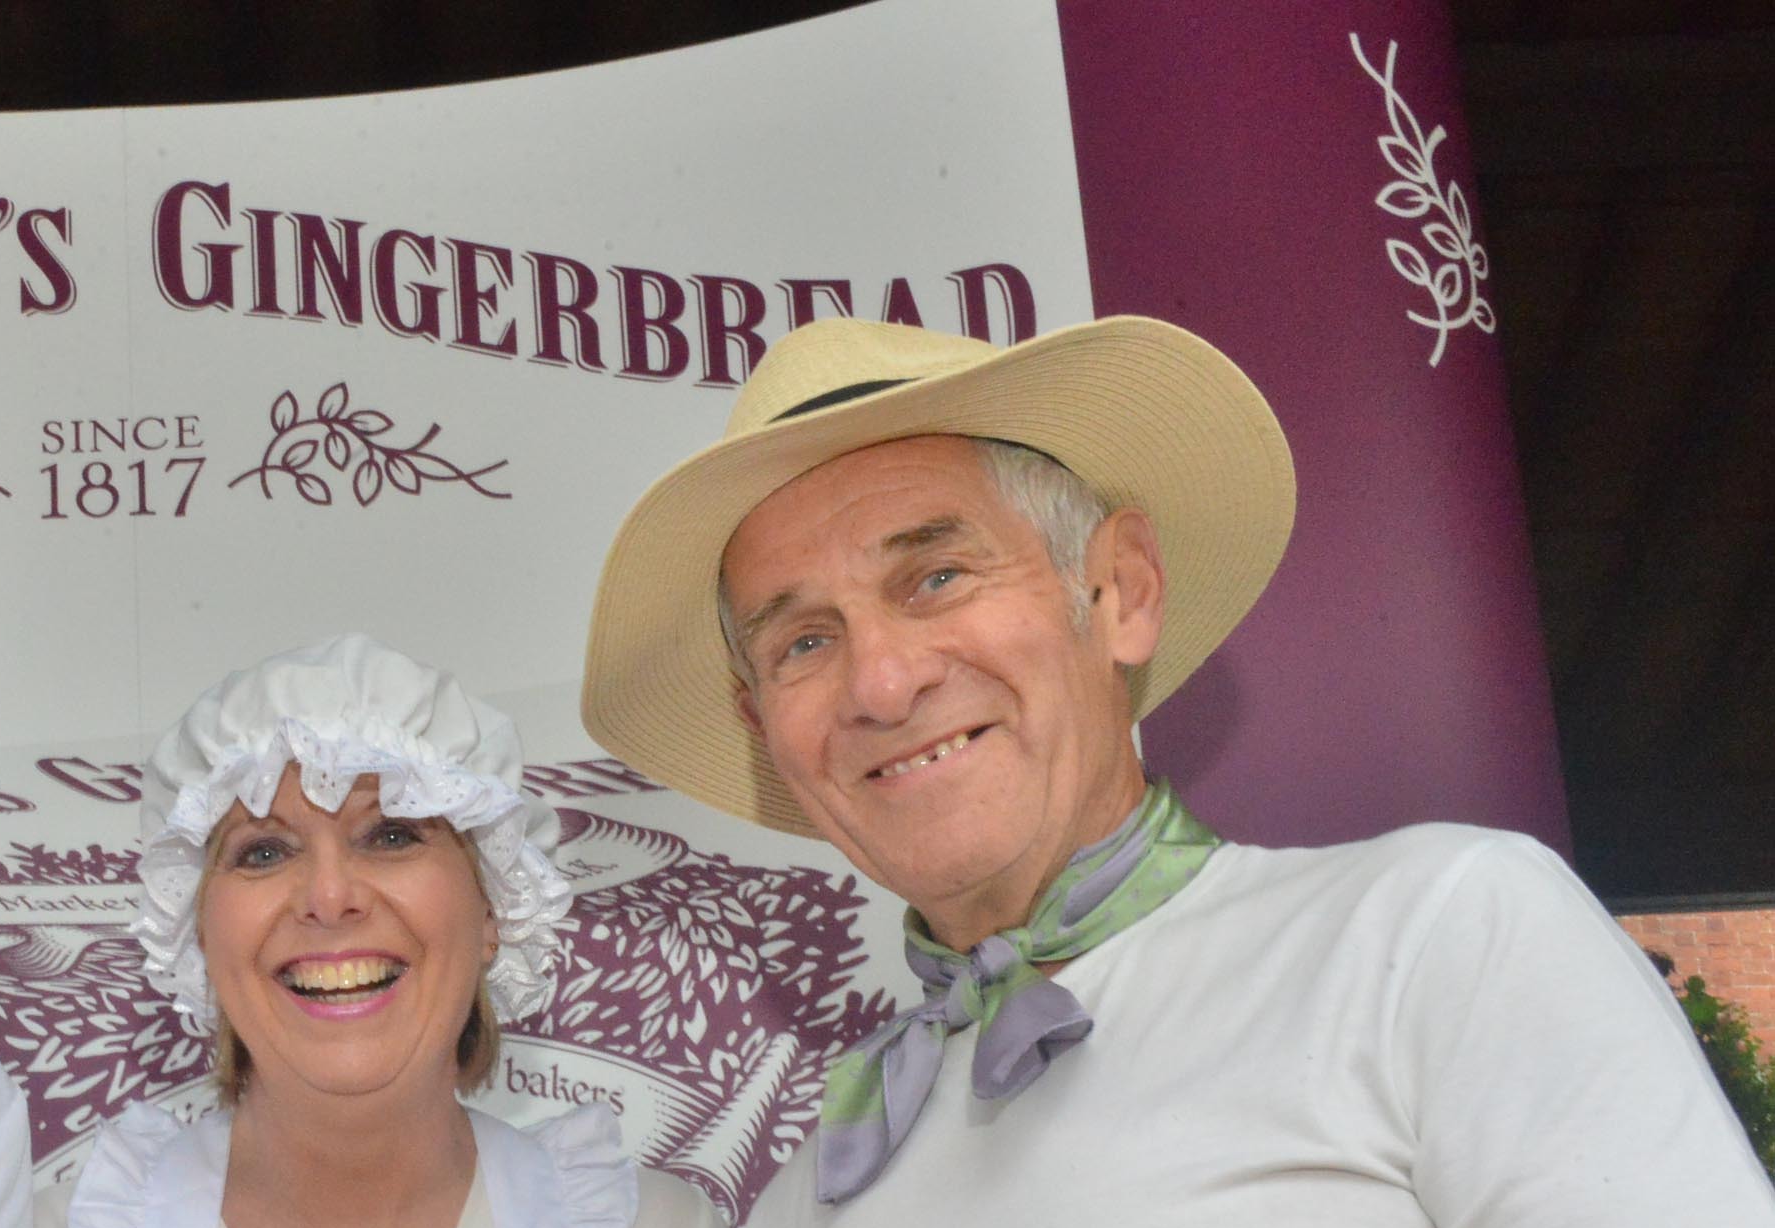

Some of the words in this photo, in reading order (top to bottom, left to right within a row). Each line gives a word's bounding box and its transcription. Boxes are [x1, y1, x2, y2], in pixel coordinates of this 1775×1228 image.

[41, 415, 204, 454] SINCE
[40, 457, 207, 519] 1817
[506, 1056, 625, 1117] bakers
